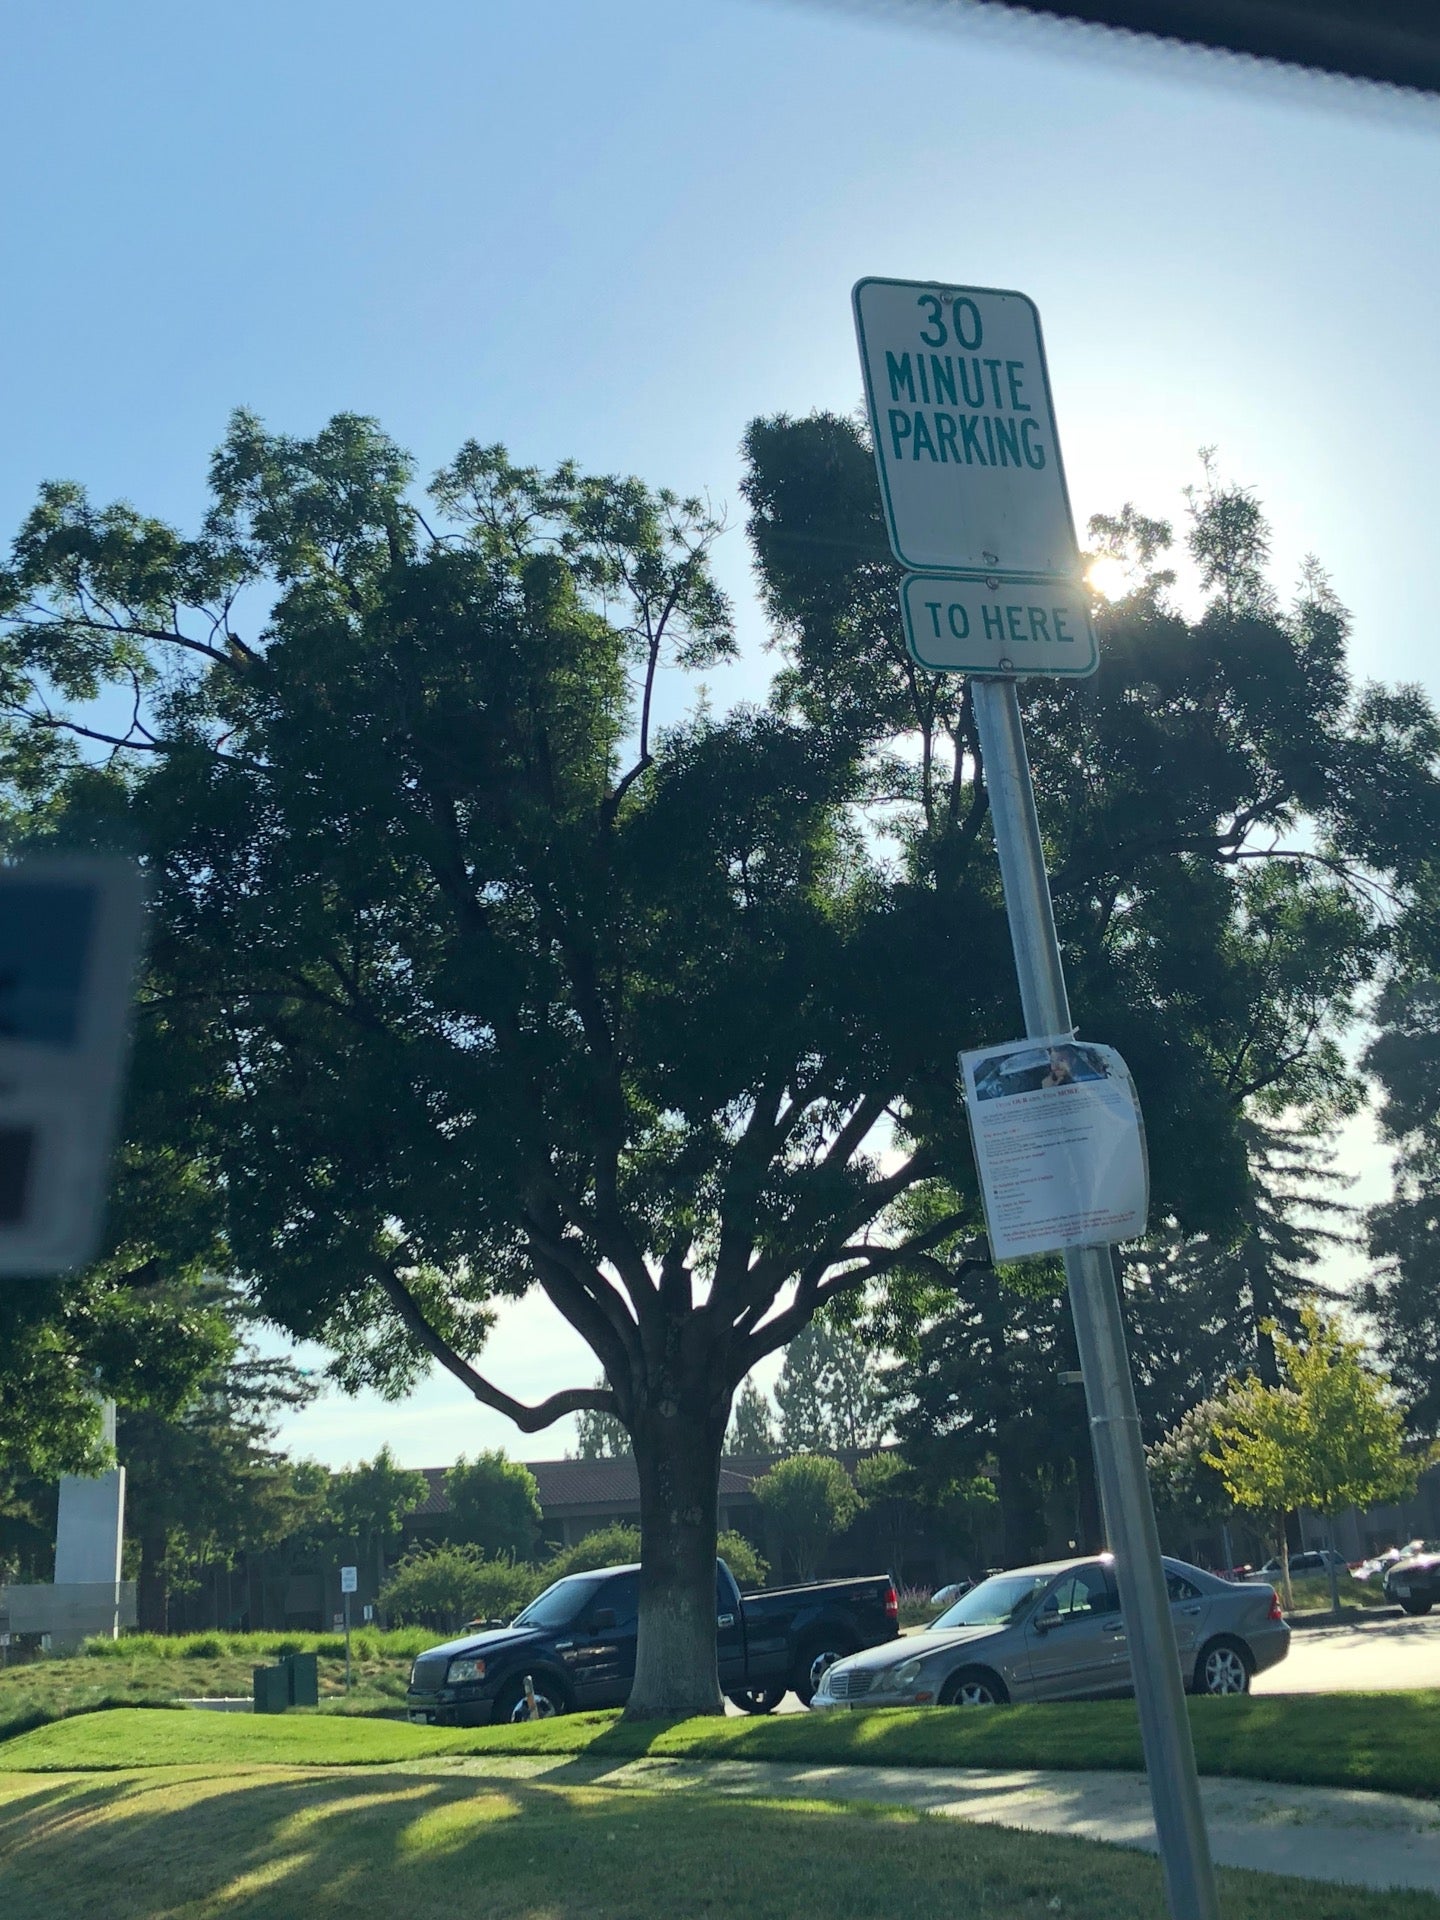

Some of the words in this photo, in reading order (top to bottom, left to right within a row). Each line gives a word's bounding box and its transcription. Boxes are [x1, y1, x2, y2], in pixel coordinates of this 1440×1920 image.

[917, 293, 983, 351] 30
[886, 351, 1031, 412] MINUTE
[888, 409, 1046, 470] PARKING
[925, 602, 970, 639] TO
[982, 604, 1075, 643] HERE
